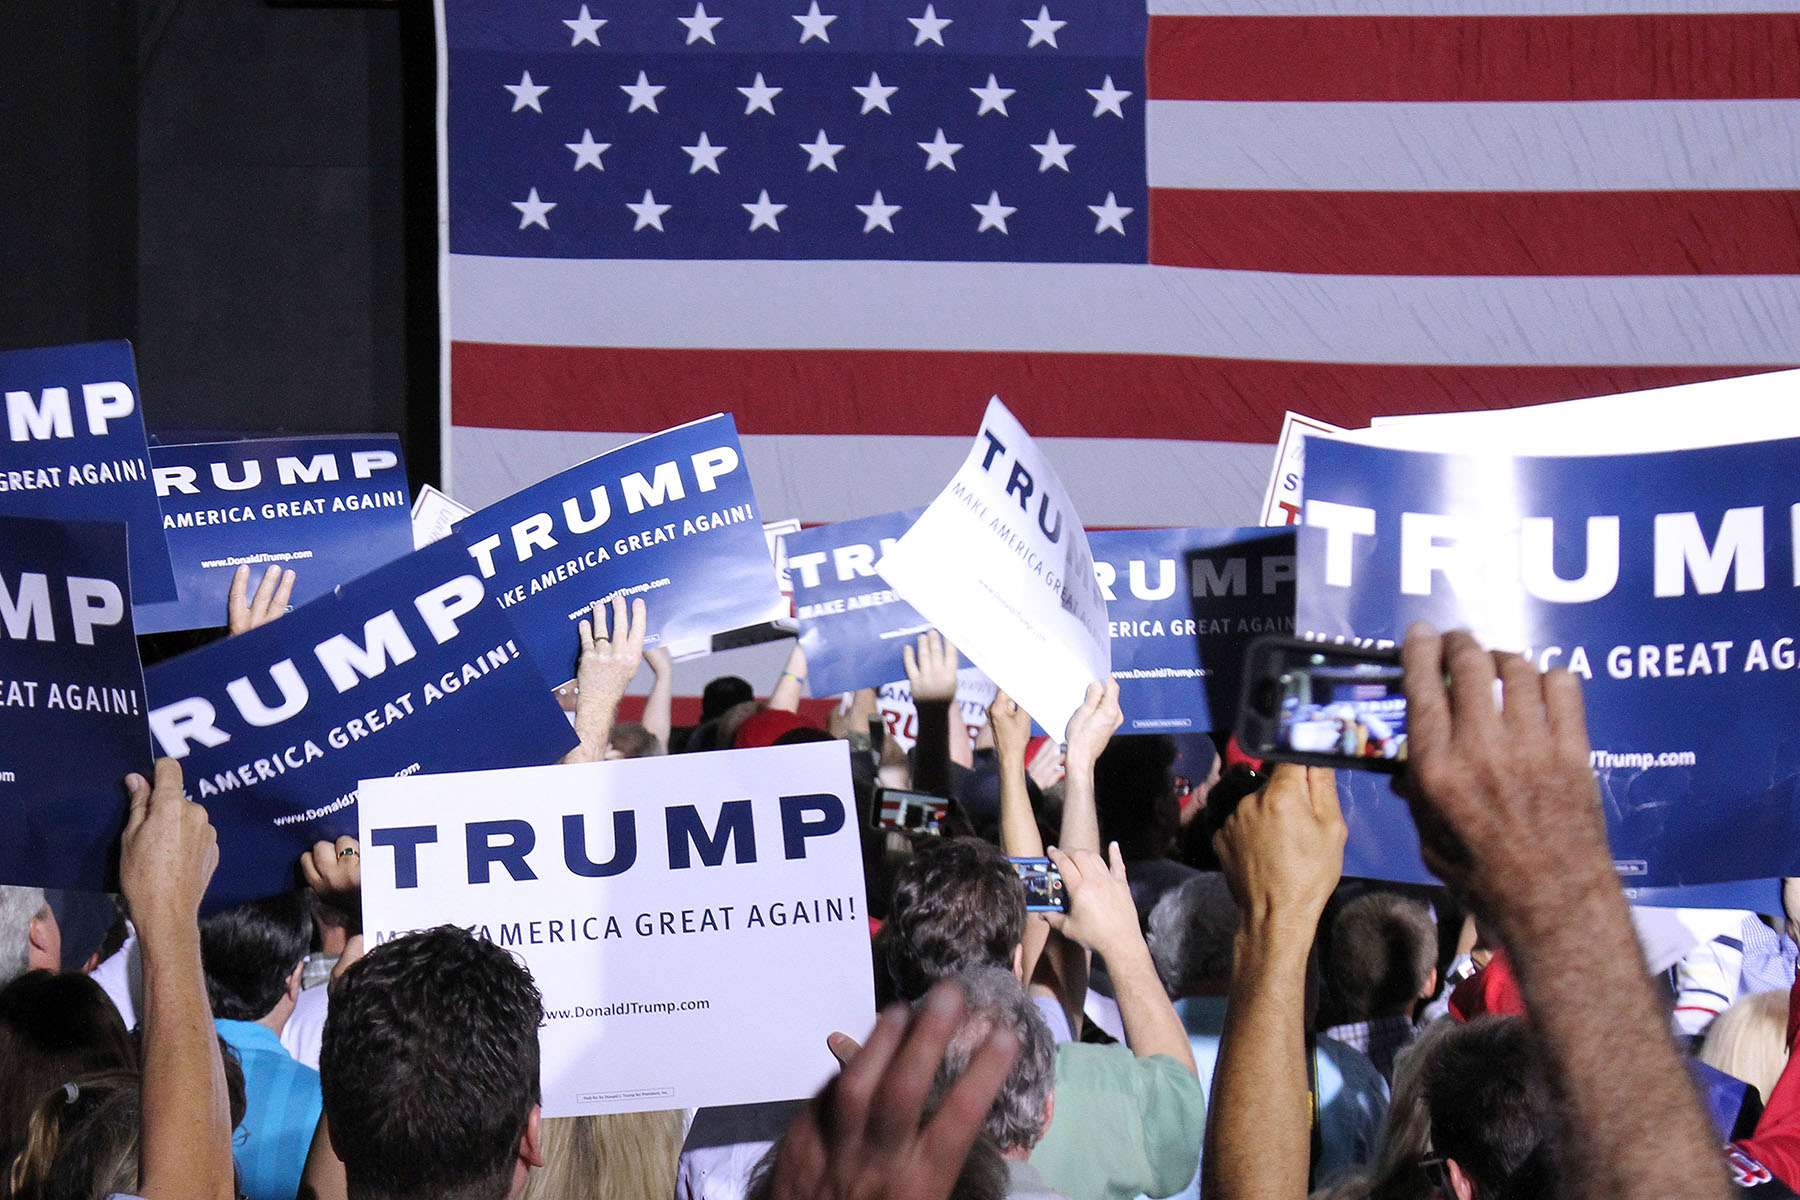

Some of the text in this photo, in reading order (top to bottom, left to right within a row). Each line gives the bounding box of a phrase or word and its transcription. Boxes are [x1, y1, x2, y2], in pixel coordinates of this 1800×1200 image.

[5, 381, 135, 442] MP
[68, 458, 147, 486] AGAIN!
[152, 450, 397, 498] RUMP
[163, 490, 404, 530] AMERICA GREAT AGAIN!
[467, 445, 740, 579] TRUMP
[201, 550, 313, 569] www.DonaldJTrump.com
[530, 546, 610, 596] AMERICA
[614, 523, 677, 556] GREAT
[683, 503, 753, 537] AGAIN!
[989, 517, 1043, 576] AMERICA
[1305, 500, 1800, 604] TRUM
[1092, 555, 1296, 601] RUMP
[1108, 620, 1165, 638] ERICA
[1170, 618, 1231, 637] GREAT
[148, 574, 486, 760] RUMP
[1607, 640, 1733, 680] GREAT
[1743, 637, 1800, 673] AG
[47, 682, 139, 716] AGAIN!
[198, 639, 520, 799] AMERICA GREAT AGAIN!
[371, 792, 846, 889] TRUMP
[478, 896, 857, 947] AMERICA GREAT AGAIN!
[545, 999, 710, 1020] ww.DonaldJTrump.com
